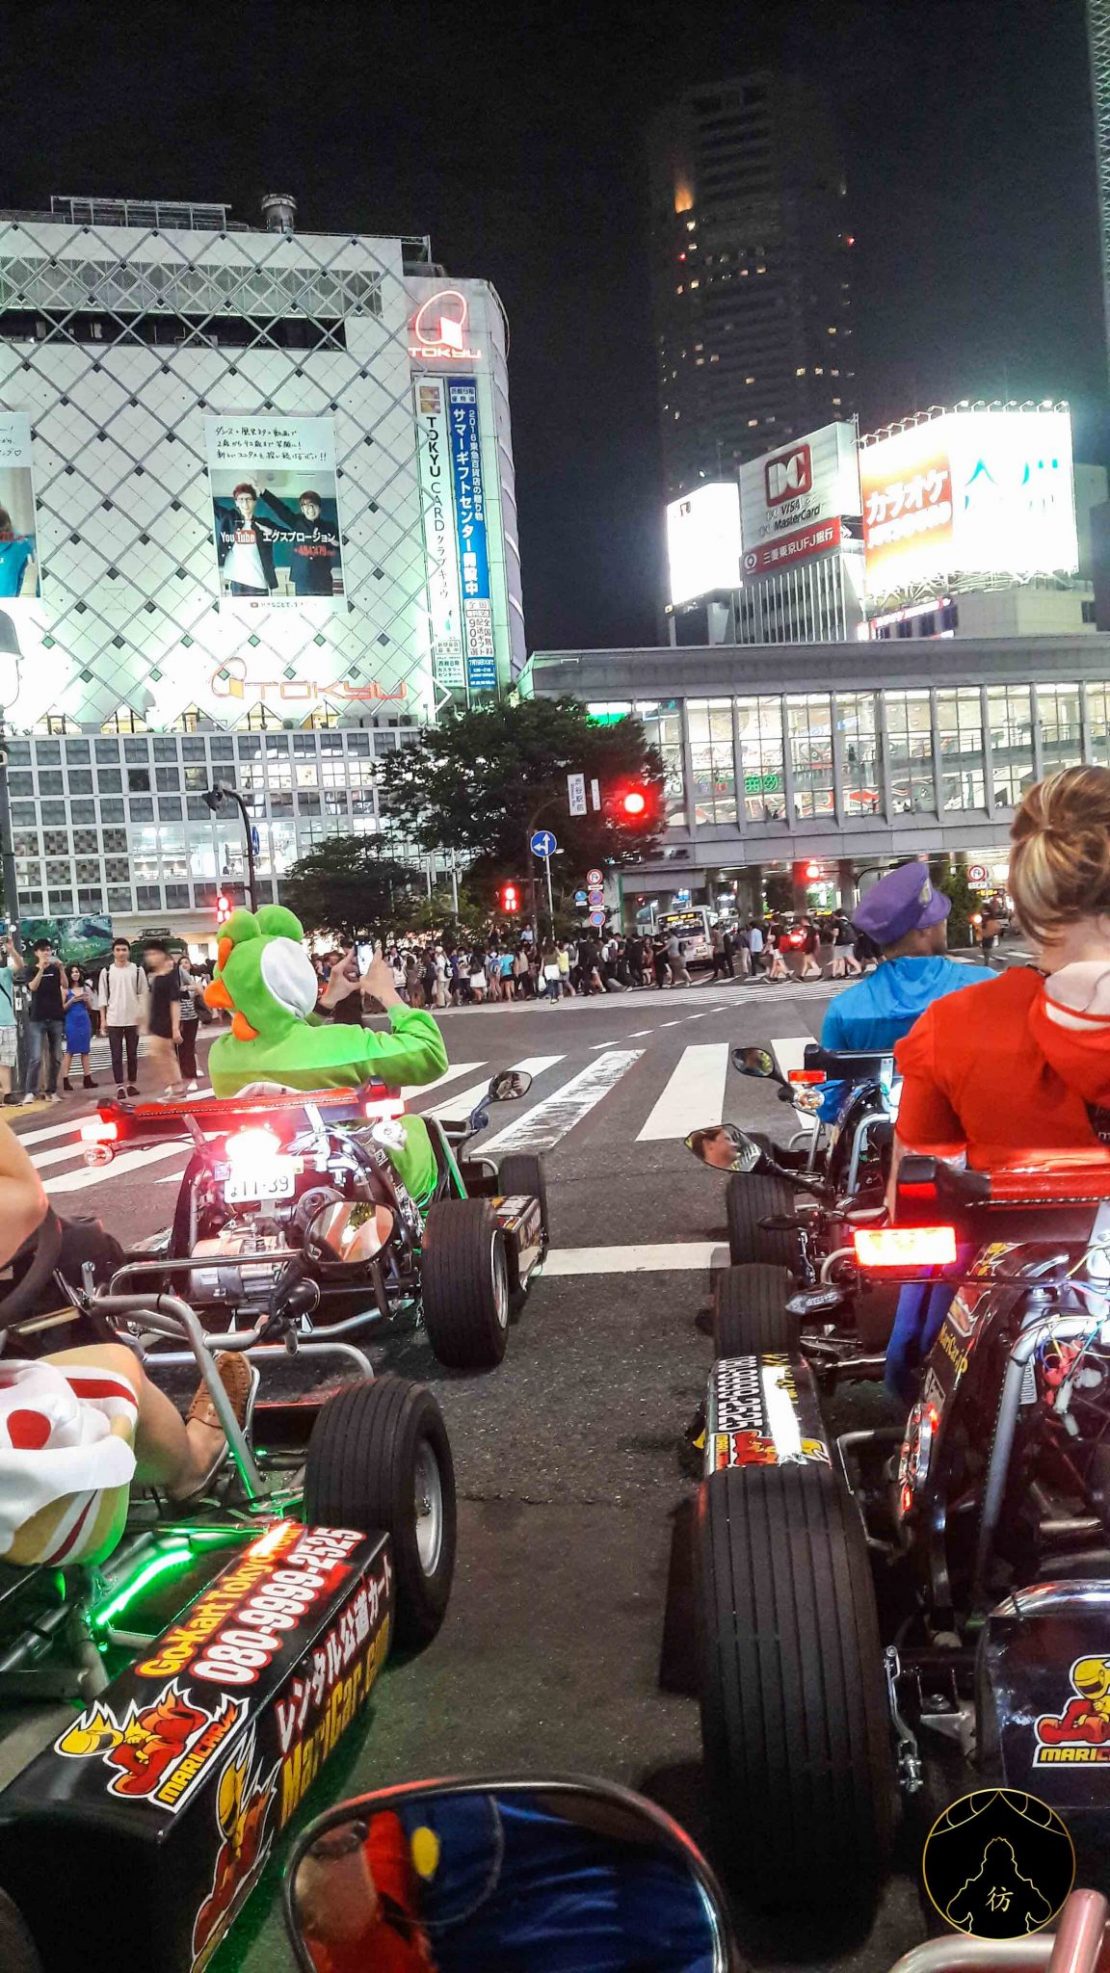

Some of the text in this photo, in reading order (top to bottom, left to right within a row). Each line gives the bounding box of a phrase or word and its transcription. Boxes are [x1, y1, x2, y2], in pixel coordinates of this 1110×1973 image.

[408, 347, 481, 359] TOKYU
[426, 416, 445, 532] TOKYU CARD
[768, 452, 806, 500] DC
[774, 503, 821, 531] MasterCard
[781, 498, 800, 515] VISA
[866, 470, 949, 526] カラオケ
[245, 680, 407, 700] TOKYU
[194, 1527, 364, 1683] 080-9999-2525
[158, 1701, 239, 1804] MARICAR
[1040, 1748, 1110, 1762] MARIC
